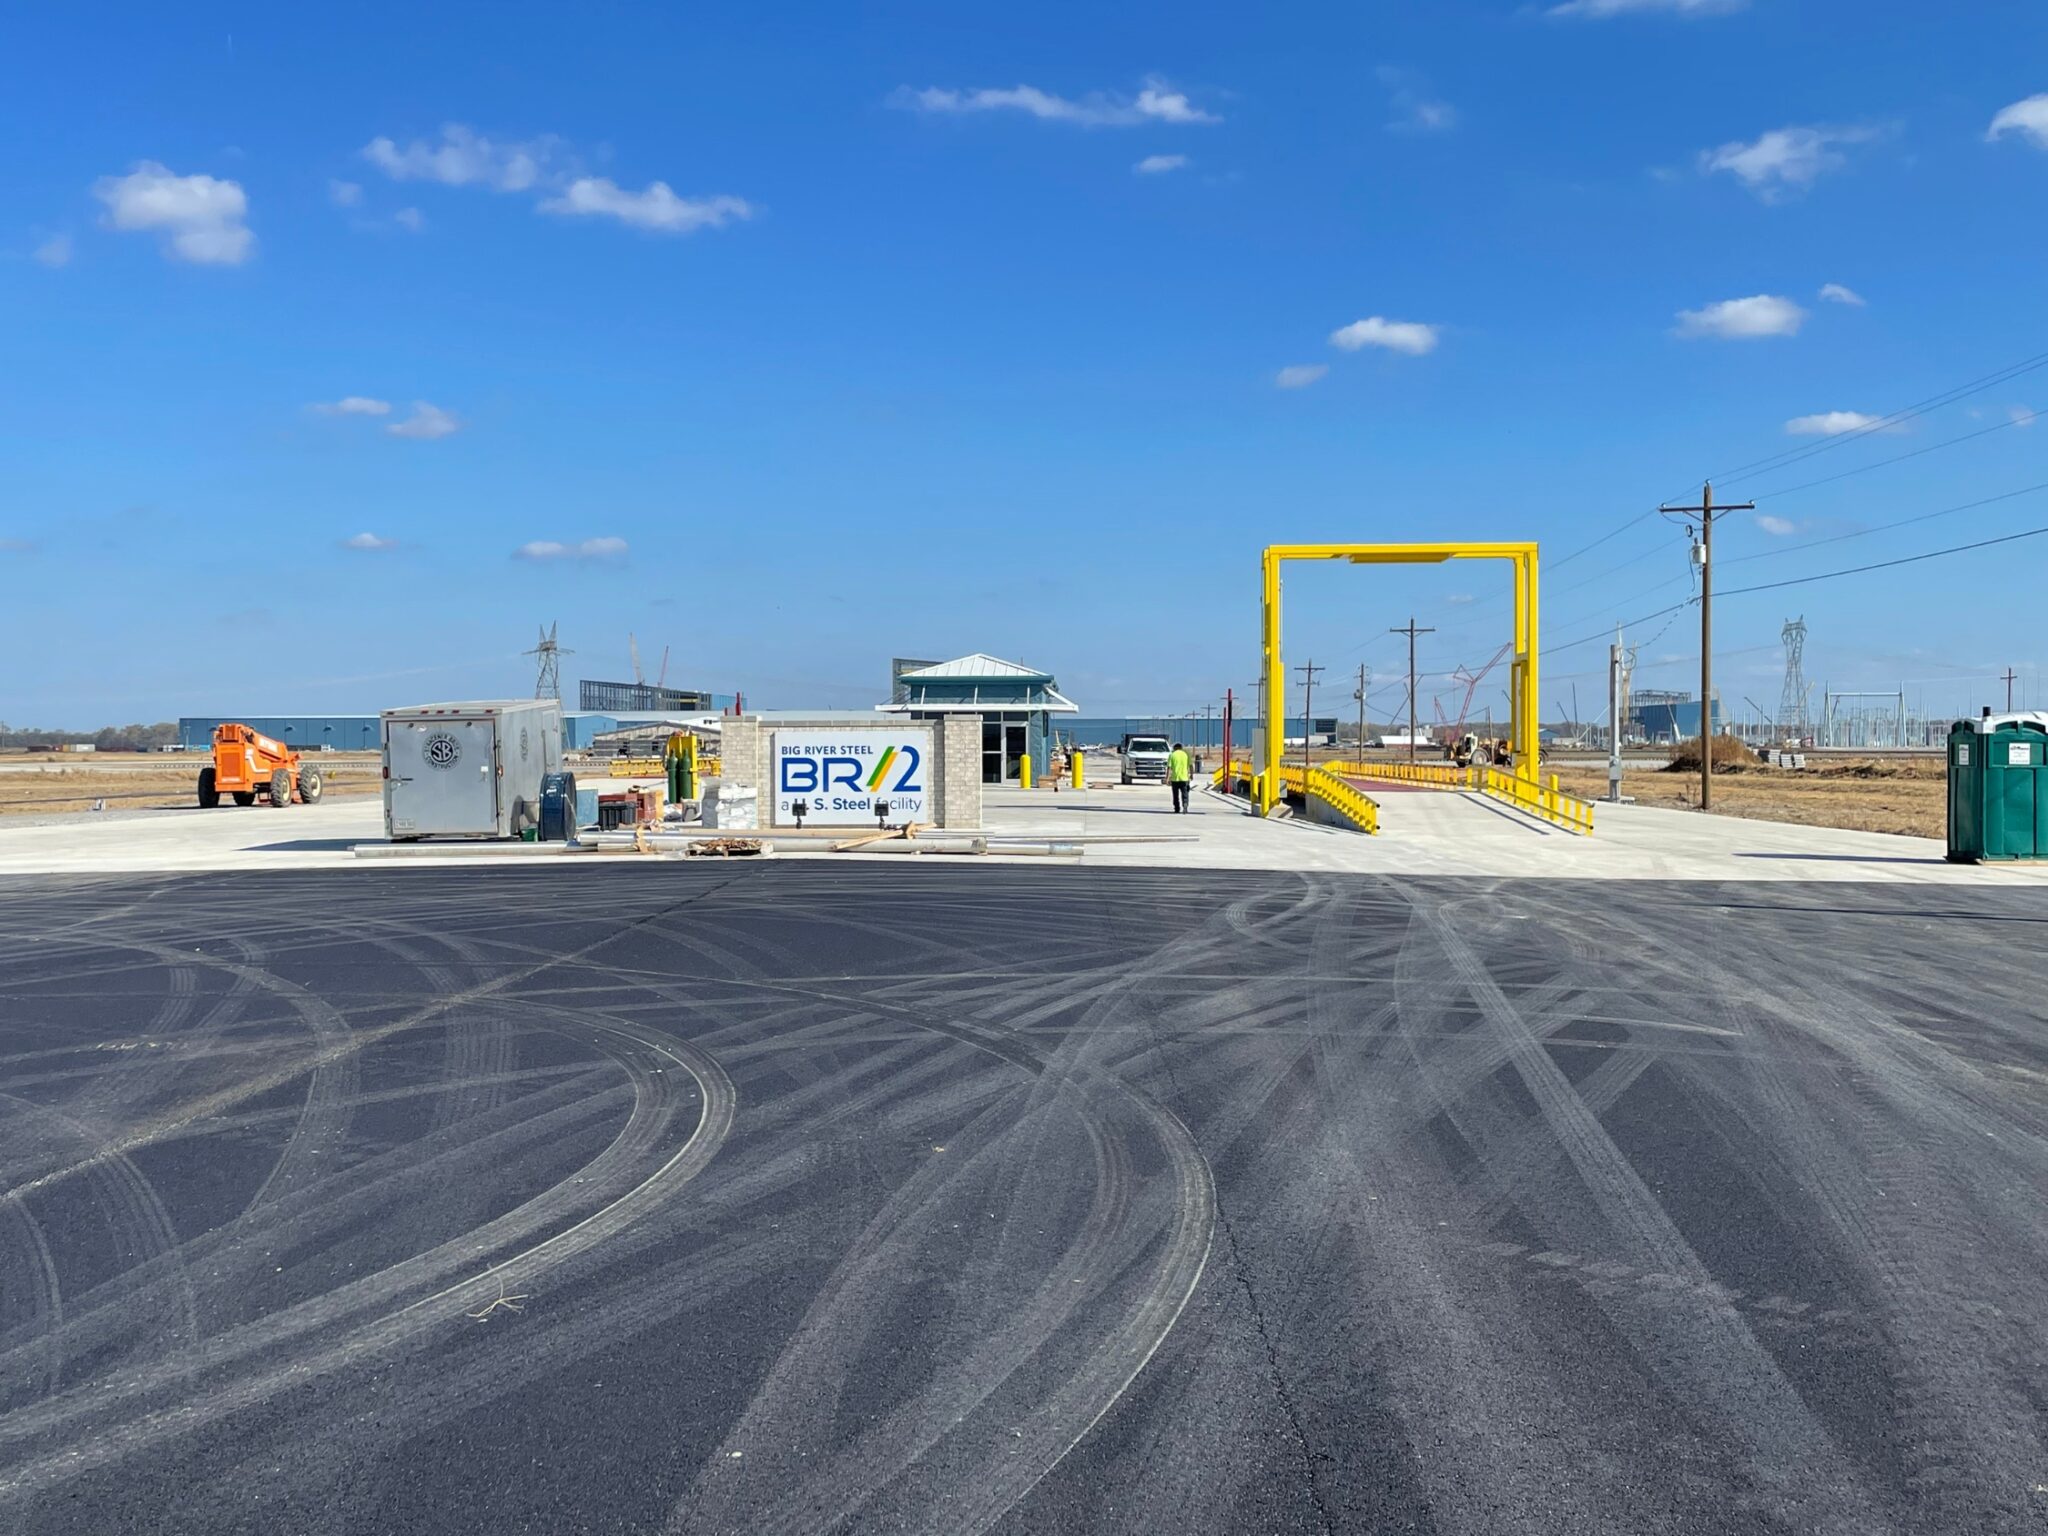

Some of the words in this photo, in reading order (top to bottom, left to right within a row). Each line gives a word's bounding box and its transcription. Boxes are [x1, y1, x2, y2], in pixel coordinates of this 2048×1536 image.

[431, 741, 452, 761] SB
[781, 746, 801, 755] BIG
[804, 746, 837, 755] RIVER
[840, 745, 874, 755] STEEL
[780, 801, 789, 811] a
[814, 798, 828, 811] S.
[832, 797, 871, 811] Steel
